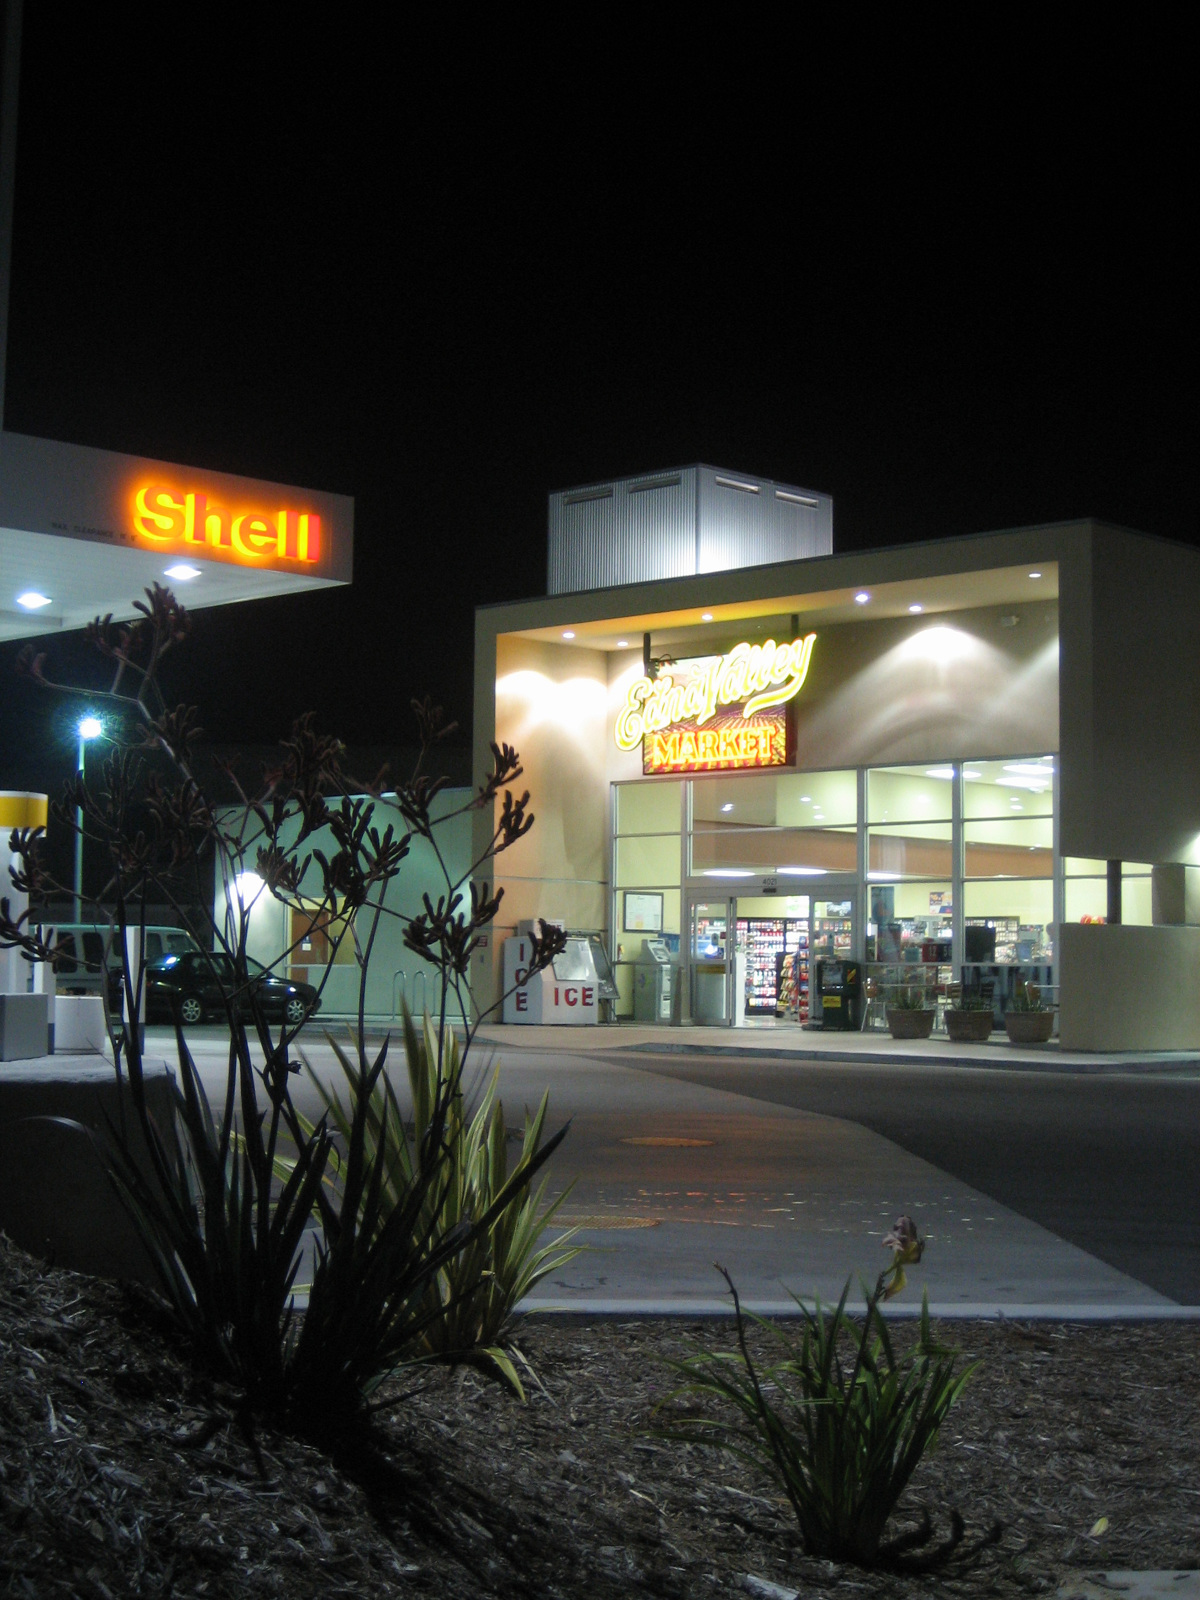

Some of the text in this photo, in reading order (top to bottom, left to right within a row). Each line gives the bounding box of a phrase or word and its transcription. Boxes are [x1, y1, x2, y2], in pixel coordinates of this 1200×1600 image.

[134, 486, 321, 563] Shell
[615, 633, 817, 751] Edna Valley
[652, 725, 776, 767] MARKET
[554, 986, 594, 1006] ICE
